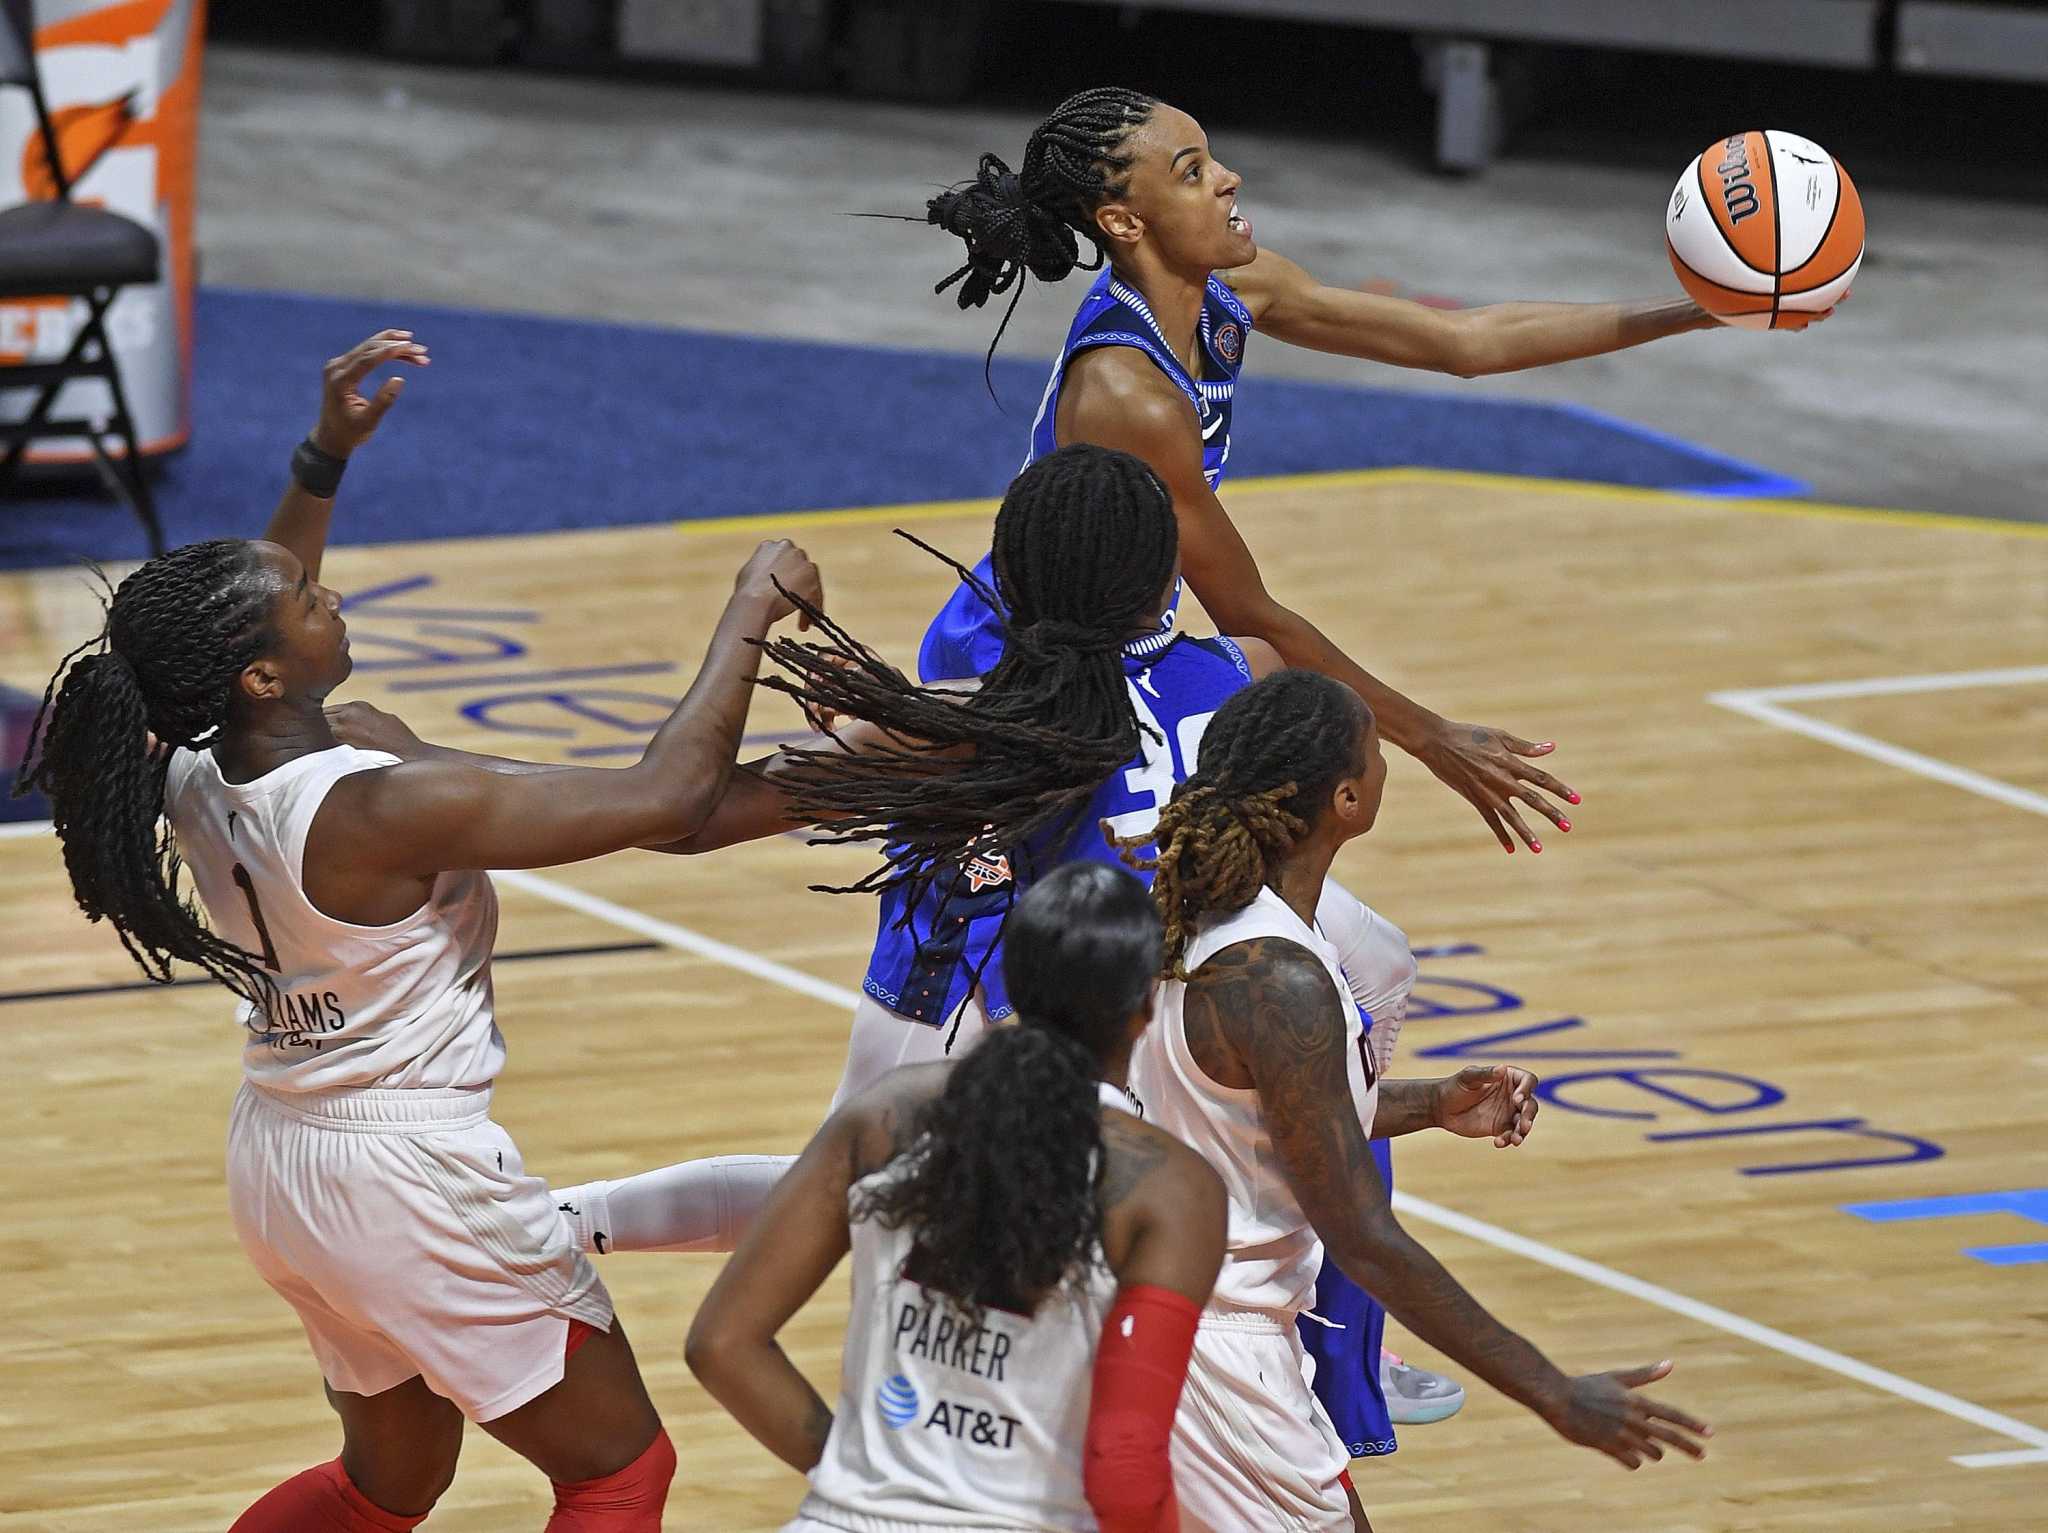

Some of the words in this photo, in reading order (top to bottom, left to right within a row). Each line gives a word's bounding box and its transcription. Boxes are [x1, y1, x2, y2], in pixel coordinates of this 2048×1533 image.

[231, 861, 282, 974] 1
[894, 1304, 1011, 1382] PARKER
[924, 1400, 1023, 1449] AT&T
